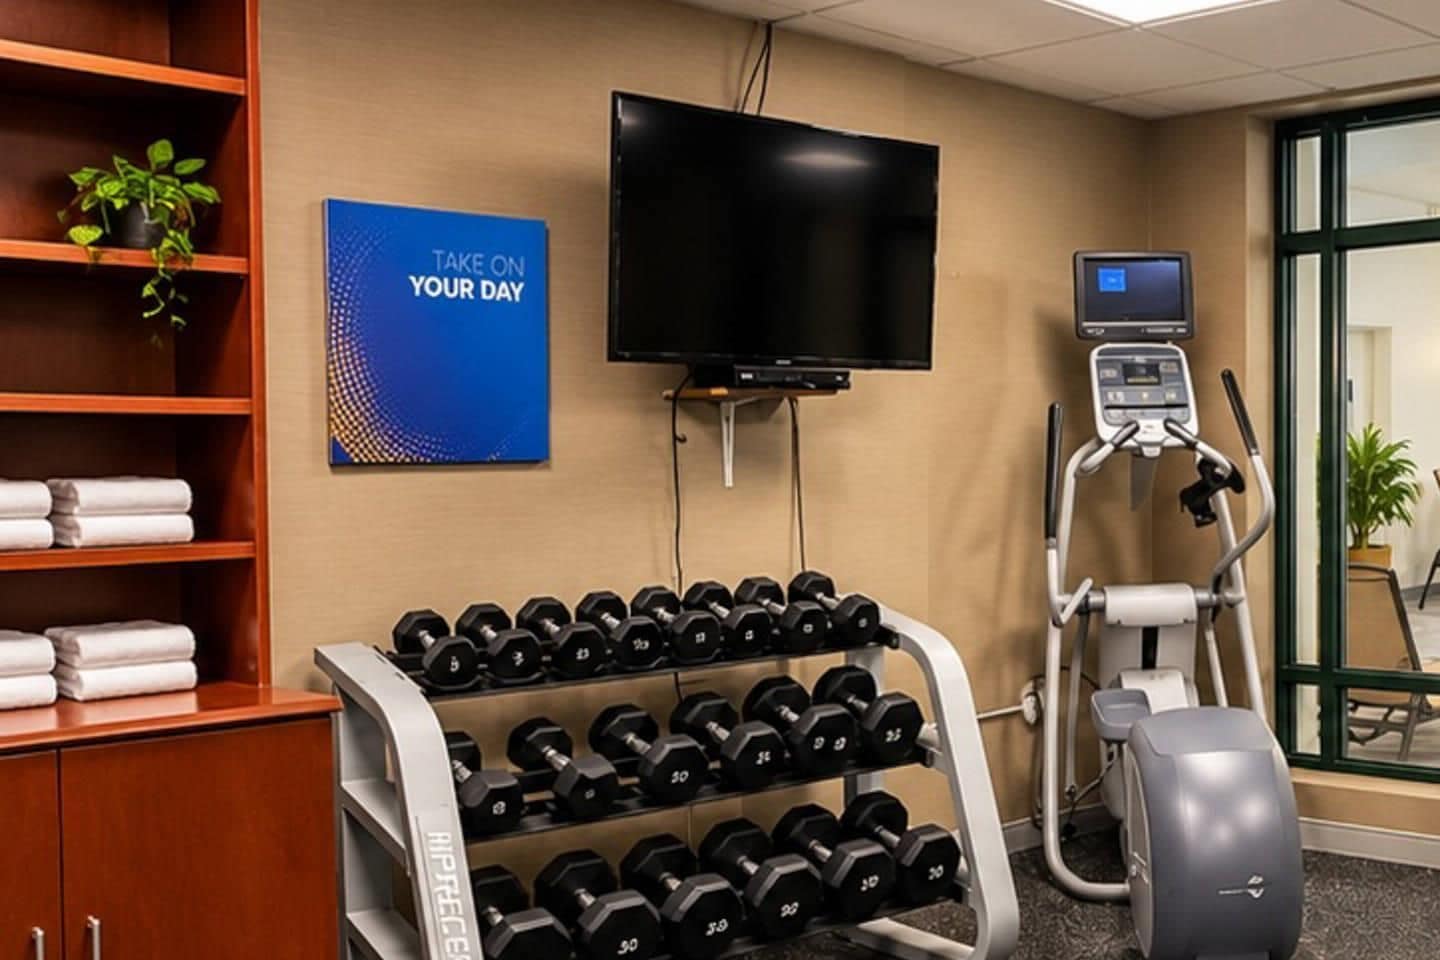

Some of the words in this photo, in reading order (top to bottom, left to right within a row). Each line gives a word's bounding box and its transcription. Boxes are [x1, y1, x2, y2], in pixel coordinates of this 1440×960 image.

[432, 249, 484, 274] TAKE
[490, 254, 526, 277] ON
[409, 275, 475, 299] YOUR
[481, 279, 525, 303] DAY
